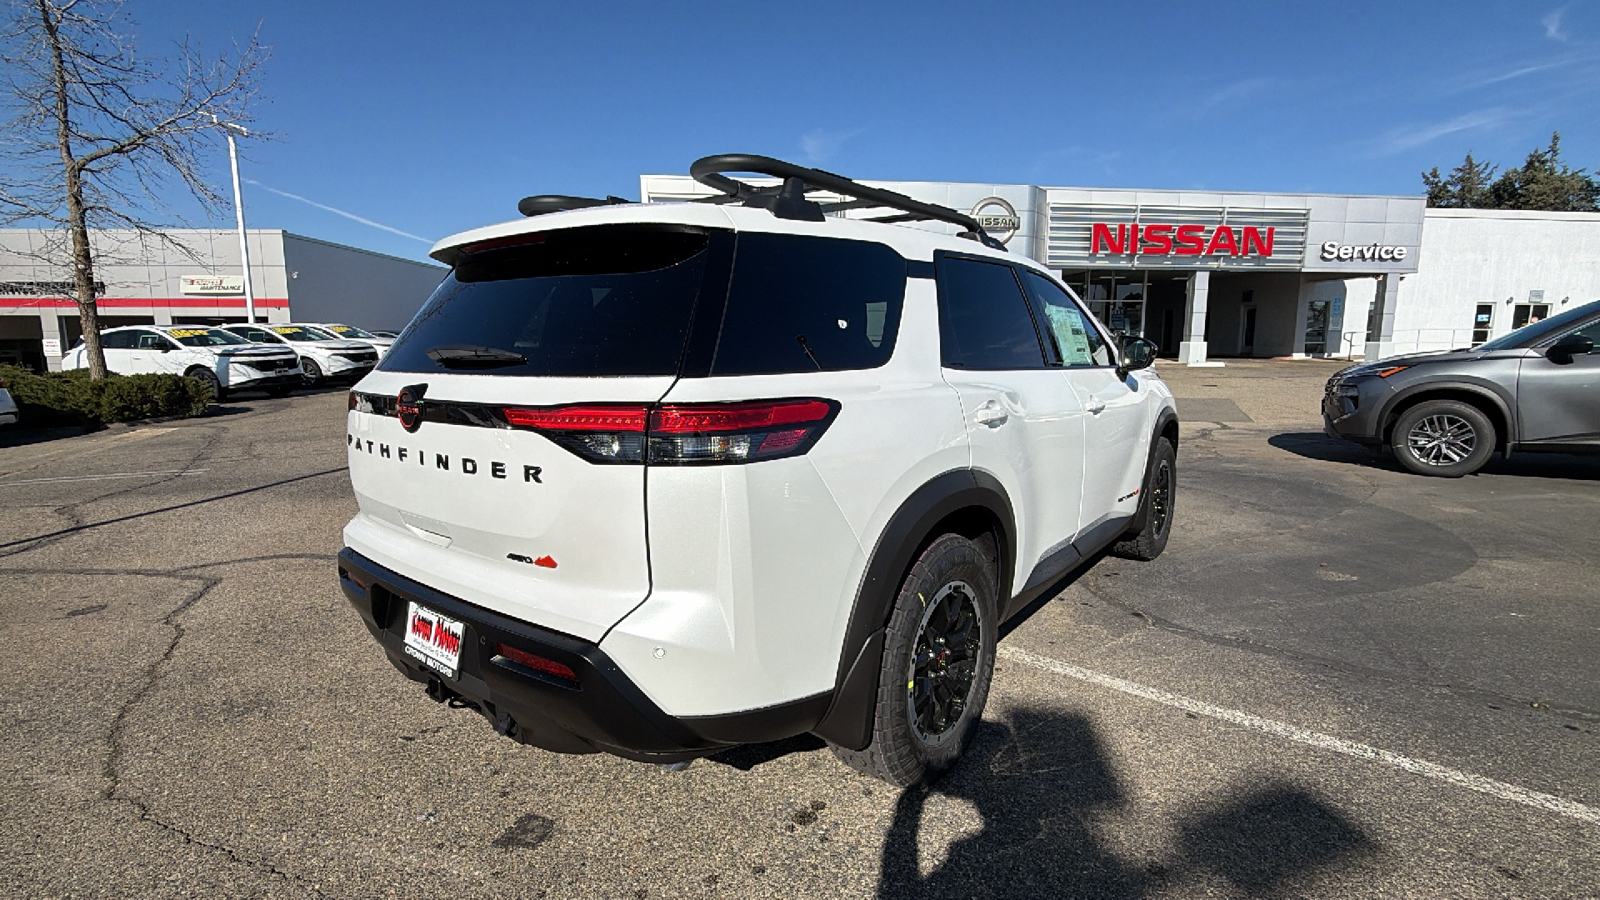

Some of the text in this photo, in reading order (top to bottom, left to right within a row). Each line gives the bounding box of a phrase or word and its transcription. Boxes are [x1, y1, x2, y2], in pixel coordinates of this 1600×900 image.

[1091, 222, 1275, 257] NISSAN
[1323, 241, 1408, 259] Service
[347, 433, 543, 484] PATHFINDER
[412, 613, 433, 643] Crown
[433, 616, 461, 657] Motors
[405, 645, 427, 663] CROWN
[426, 657, 453, 677] MOTORS
